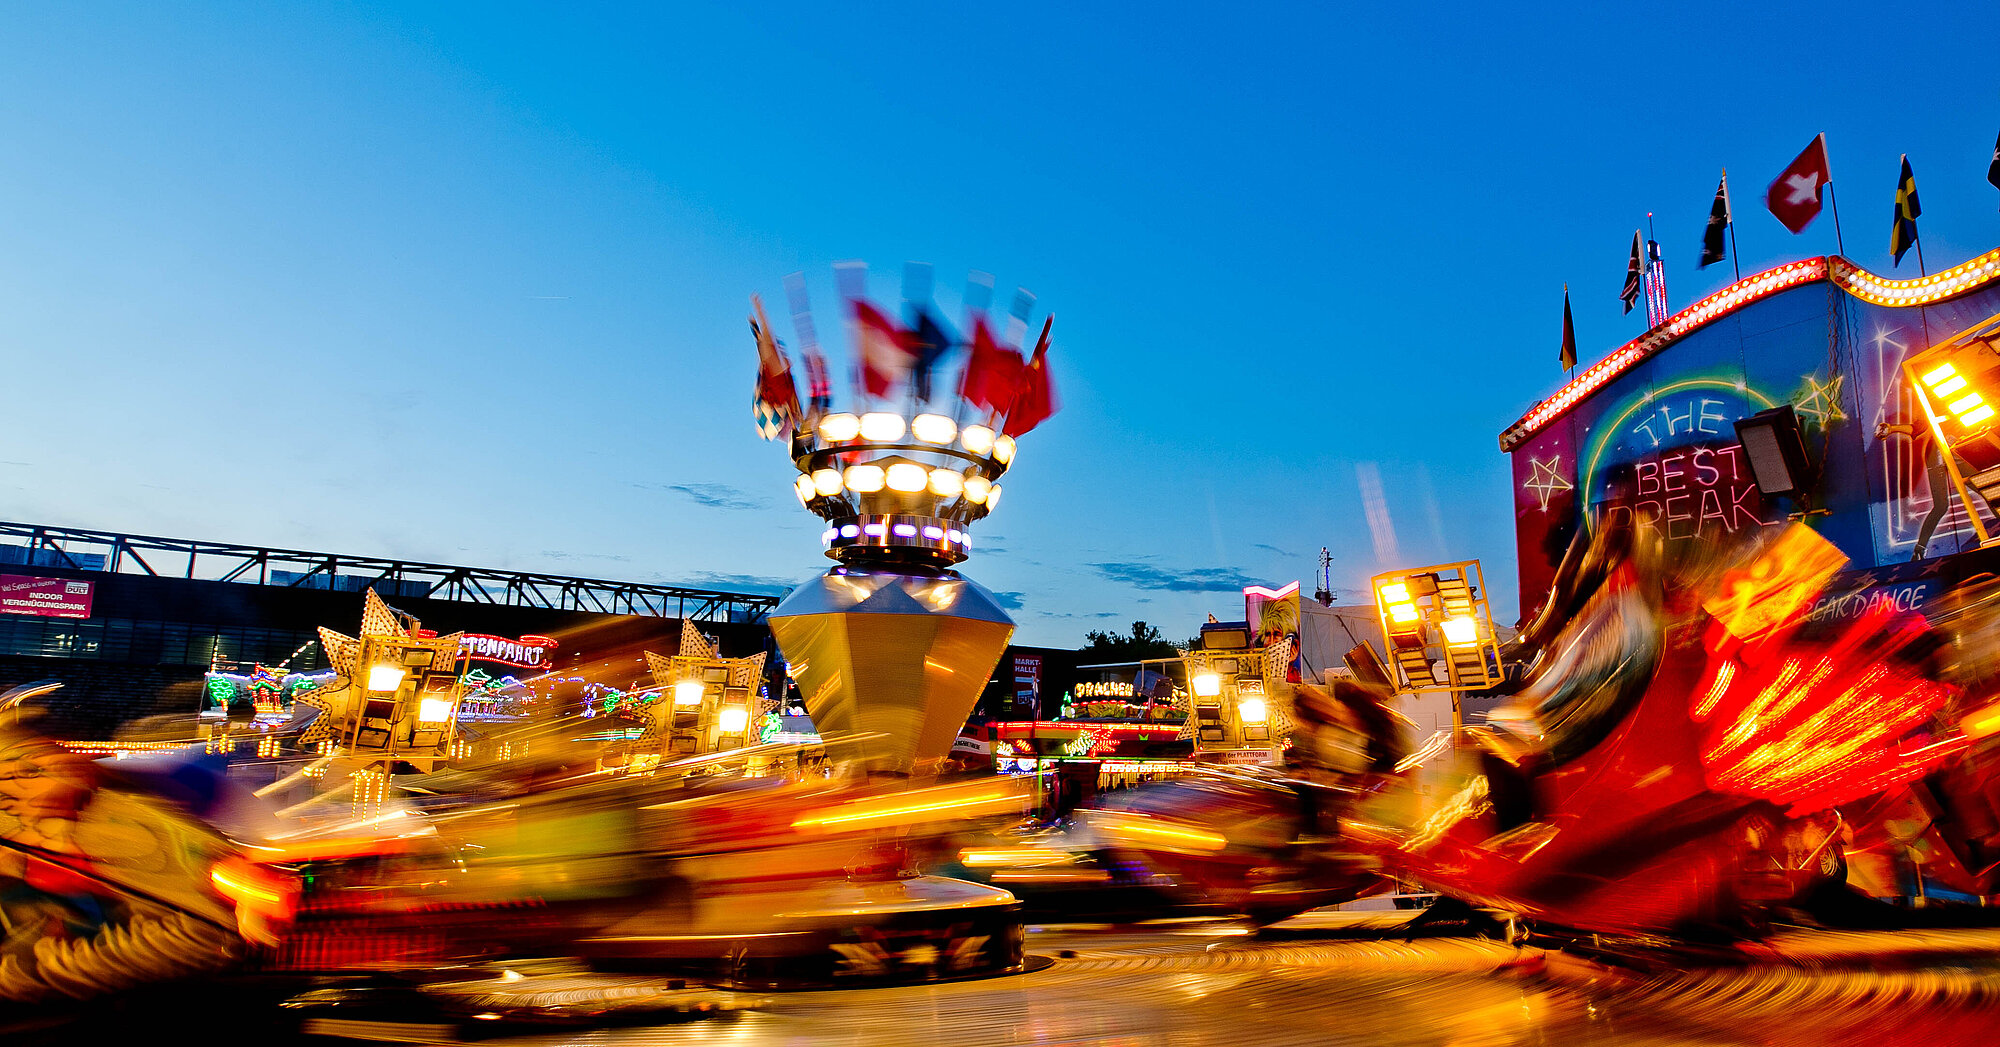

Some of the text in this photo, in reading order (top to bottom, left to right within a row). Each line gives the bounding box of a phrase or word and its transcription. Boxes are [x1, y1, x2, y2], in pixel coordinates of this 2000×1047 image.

[1632, 397, 1728, 446] THE
[1635, 444, 1743, 496] BEST
[29, 592, 63, 601] INDOOR
[1800, 584, 1927, 623] REAK DANCE
[2, 598, 86, 611] VERGNÜGUNGSPARK
[1015, 658, 1041, 666] MARKT-
[1015, 666, 1037, 674] HALLE
[1075, 681, 1134, 699] DRACHEN
